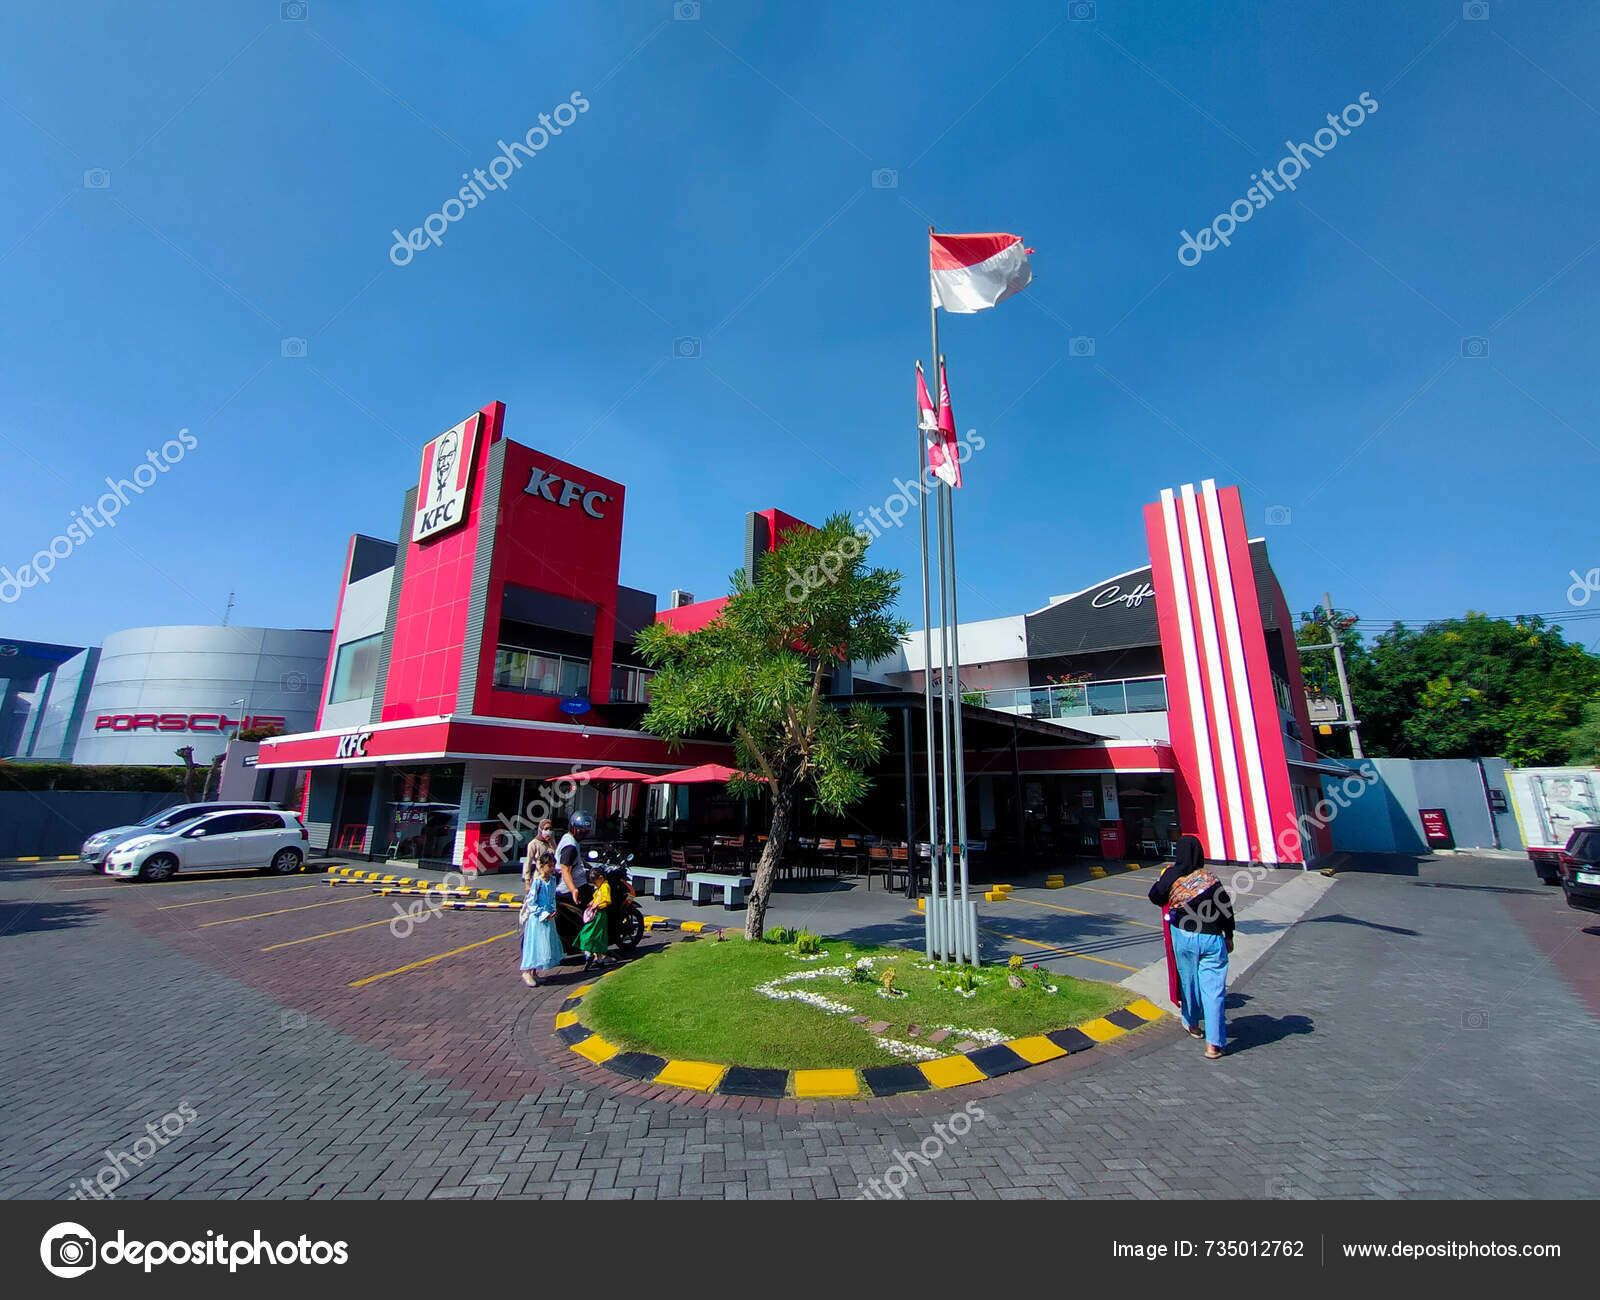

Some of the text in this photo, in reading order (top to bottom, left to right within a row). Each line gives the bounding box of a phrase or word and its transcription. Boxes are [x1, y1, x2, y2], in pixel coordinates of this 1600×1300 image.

[524, 466, 605, 519] KFC
[420, 499, 456, 534] KFC
[1091, 582, 1156, 608] Coffe
[94, 713, 286, 732] PORSCHE
[336, 733, 370, 758] KFC
